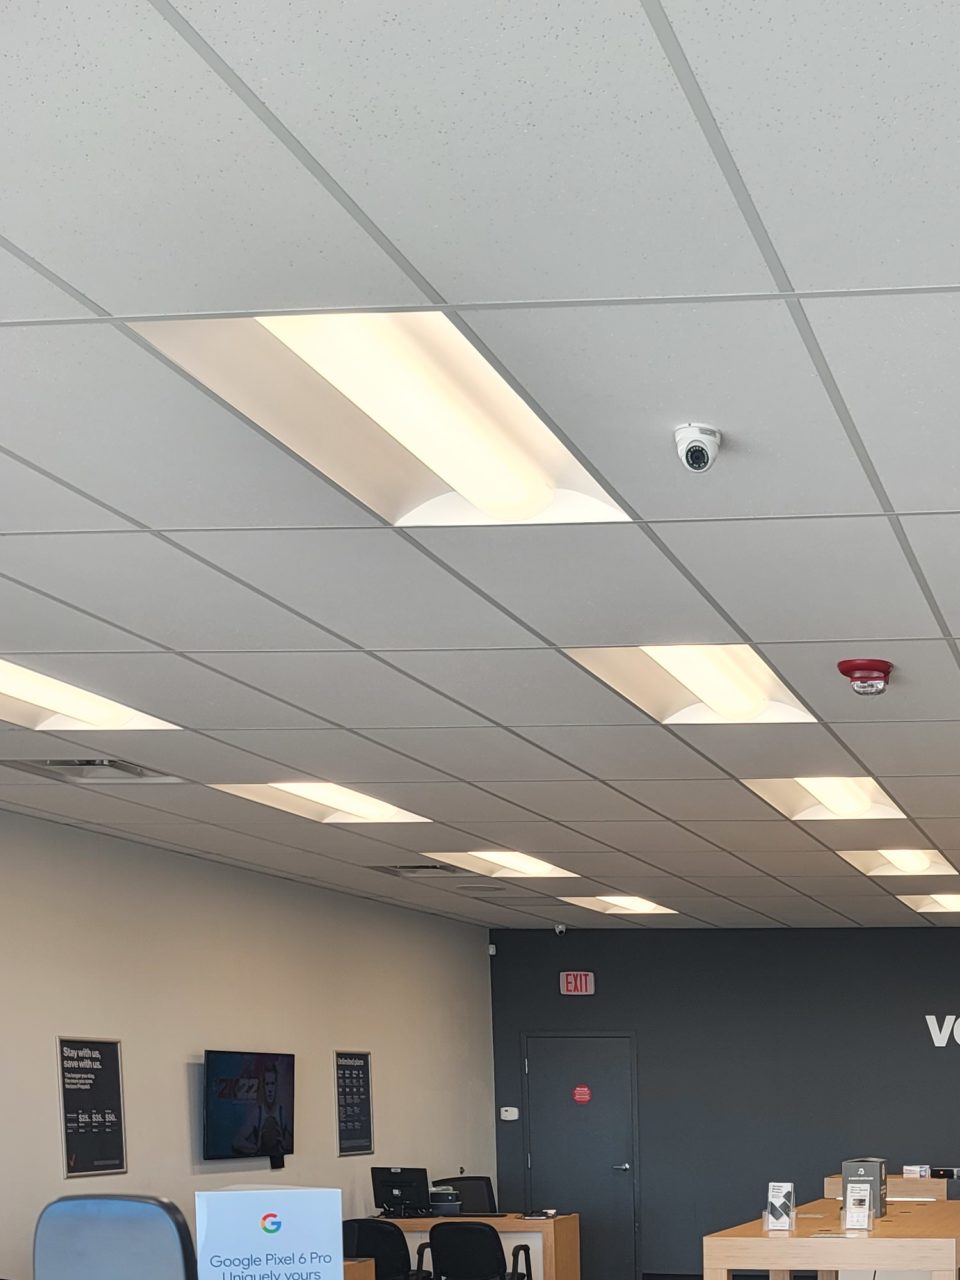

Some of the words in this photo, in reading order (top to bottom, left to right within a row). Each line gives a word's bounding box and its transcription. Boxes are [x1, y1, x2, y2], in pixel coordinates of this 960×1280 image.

[565, 973, 589, 992] EXIT
[63, 1046, 77, 1059] Stay
[78, 1048, 91, 1058] with
[63, 1060, 78, 1068] save
[79, 1059, 92, 1069] with
[209, 1254, 262, 1270] Google
[265, 1253, 295, 1266] Pixel
[298, 1253, 307, 1264] 6
[310, 1252, 332, 1264] Pro
